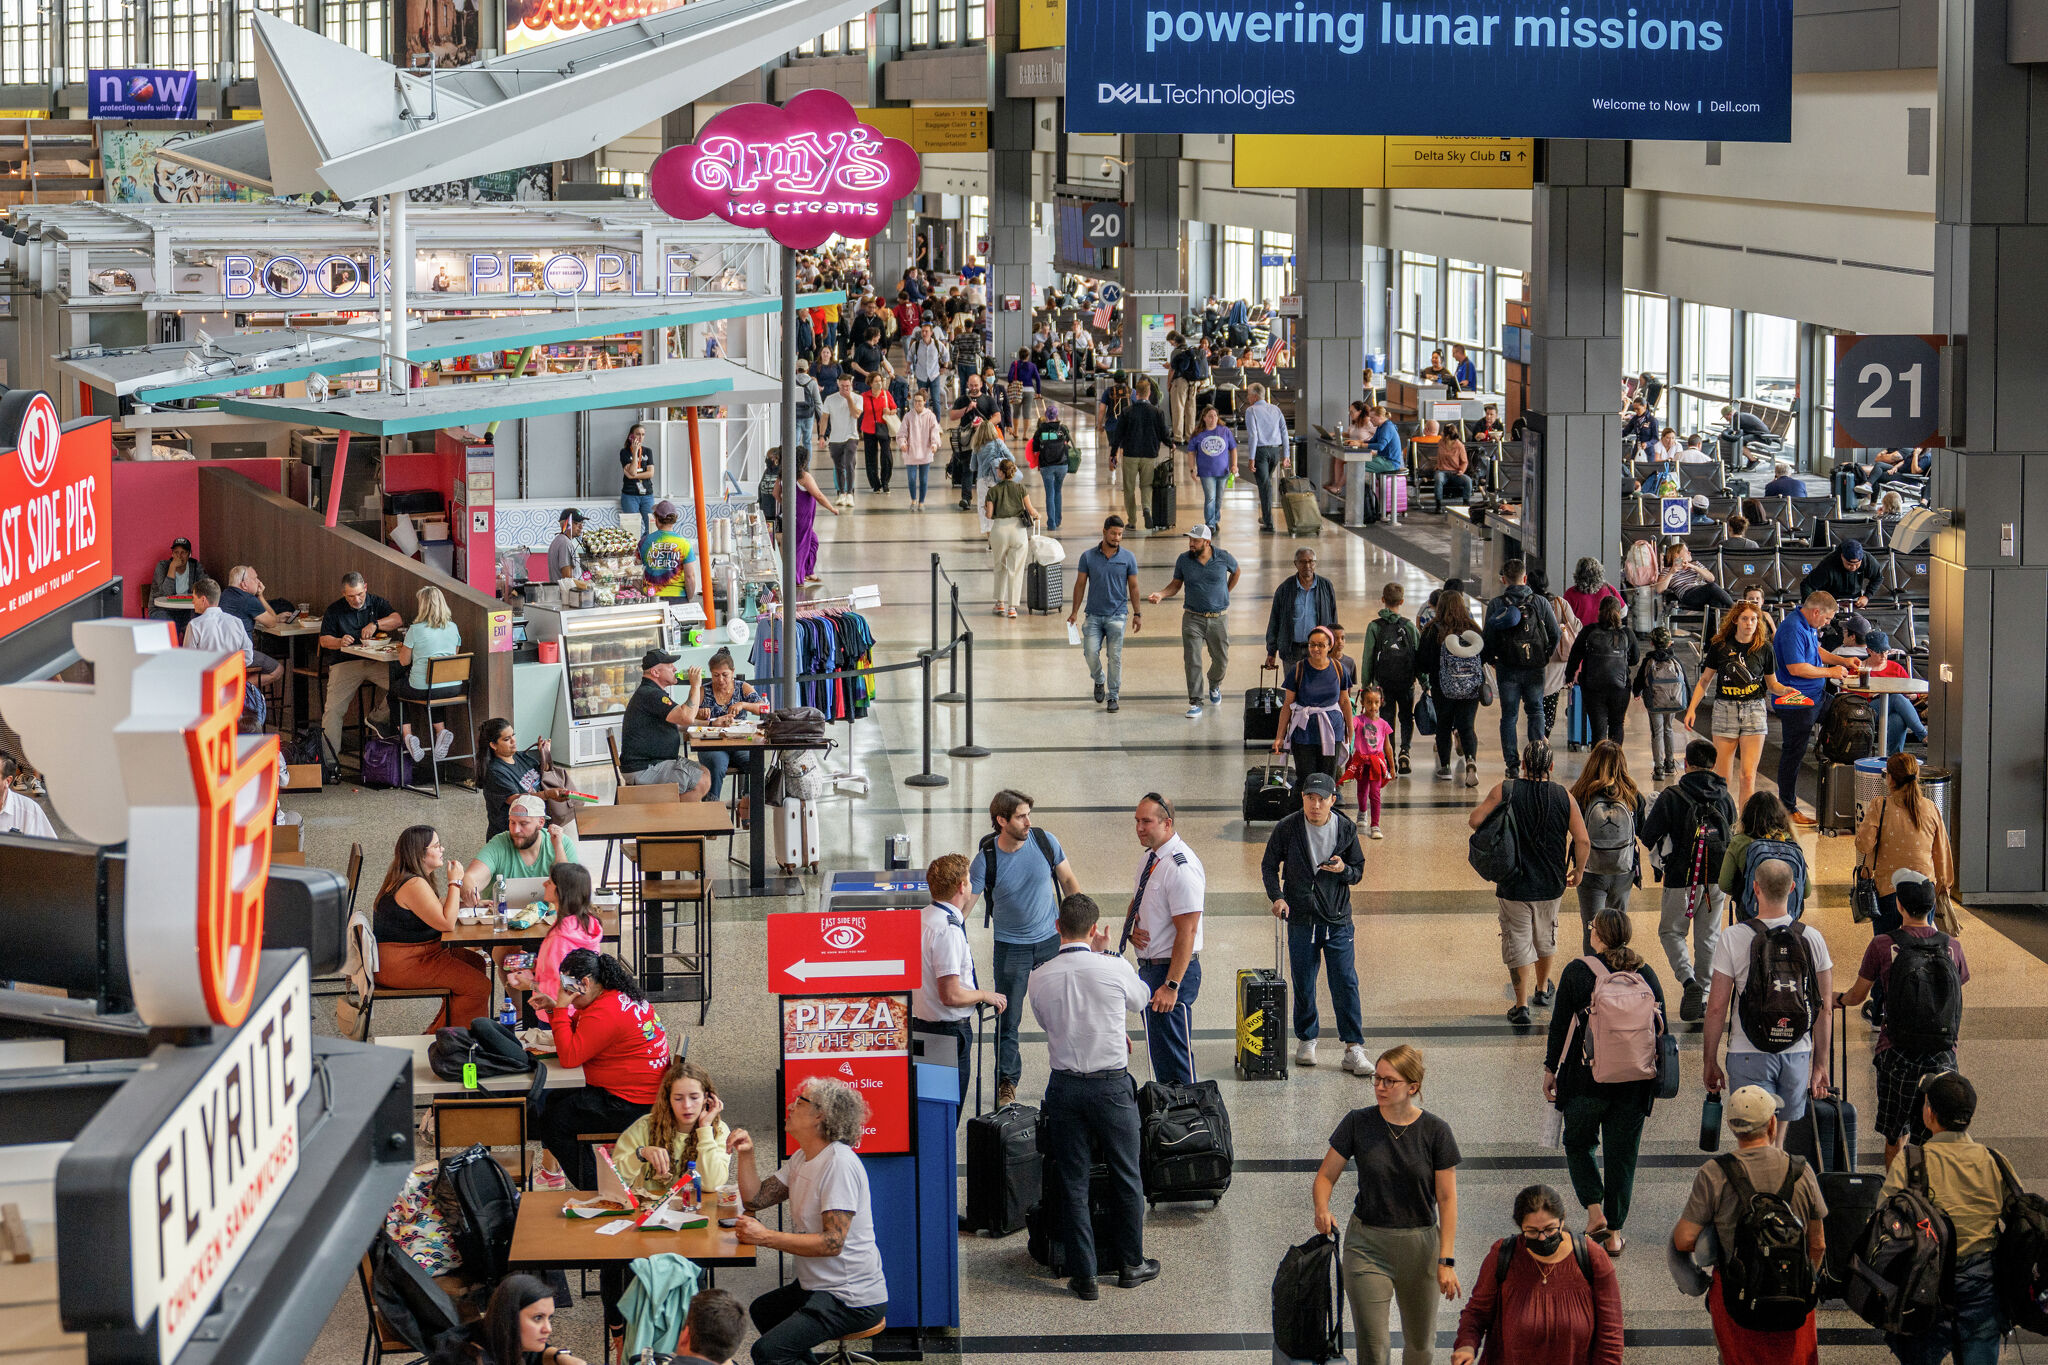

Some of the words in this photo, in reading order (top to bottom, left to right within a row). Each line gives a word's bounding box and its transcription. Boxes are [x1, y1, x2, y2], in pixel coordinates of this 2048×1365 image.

[1145, 1, 1365, 55] powering
[1381, 1, 1500, 46] lunar
[1514, 6, 1724, 51] missions
[1050, 57, 1065, 84] JOR
[1097, 82, 1162, 105] DELL
[1161, 83, 1296, 110] Technologies
[100, 103, 136, 113] protecting
[136, 103, 155, 112] reefs
[155, 103, 171, 112] with
[172, 103, 187, 112] data
[1592, 98, 1646, 112] Welcome
[1648, 99, 1661, 112] to
[1663, 99, 1691, 112] Now
[1709, 100, 1761, 113] Dell.com
[1414, 150, 1444, 161] Delta
[1447, 150, 1466, 164] Sky
[1470, 150, 1496, 161] Club
[773, 200, 880, 217] creams
[1089, 213, 1121, 238] 20
[225, 254, 392, 300] BOOK
[471, 253, 693, 298] PEOPLE
[1856, 362, 1922, 418] 21
[27, 489, 62, 575] SIDE
[65, 474, 97, 556] PIES
[651, 541, 679, 551] KEEP
[646, 550, 681, 561] AUSTIN
[648, 559, 679, 568] WEIRD
[18, 590, 33, 608] KNOW
[34, 582, 48, 599] WHAT
[50, 575, 60, 591] YOU
[61, 569, 75, 587] WANT
[493, 625, 507, 637] EXIT
[820, 917, 836, 933] EAST
[837, 917, 851, 925] SIDE
[852, 917, 867, 930] PIES
[1780, 947, 1788, 955] 22
[795, 1002, 896, 1031] PIZZA
[796, 1033, 818, 1049] BY
[819, 1033, 849, 1048] THE
[853, 1032, 895, 1047] SLICE
[860, 1078, 884, 1089] Slice
[154, 993, 297, 1282] FLYRITE
[164, 1231, 223, 1335] CHICKEN
[225, 1124, 295, 1250] SANDWICHES
